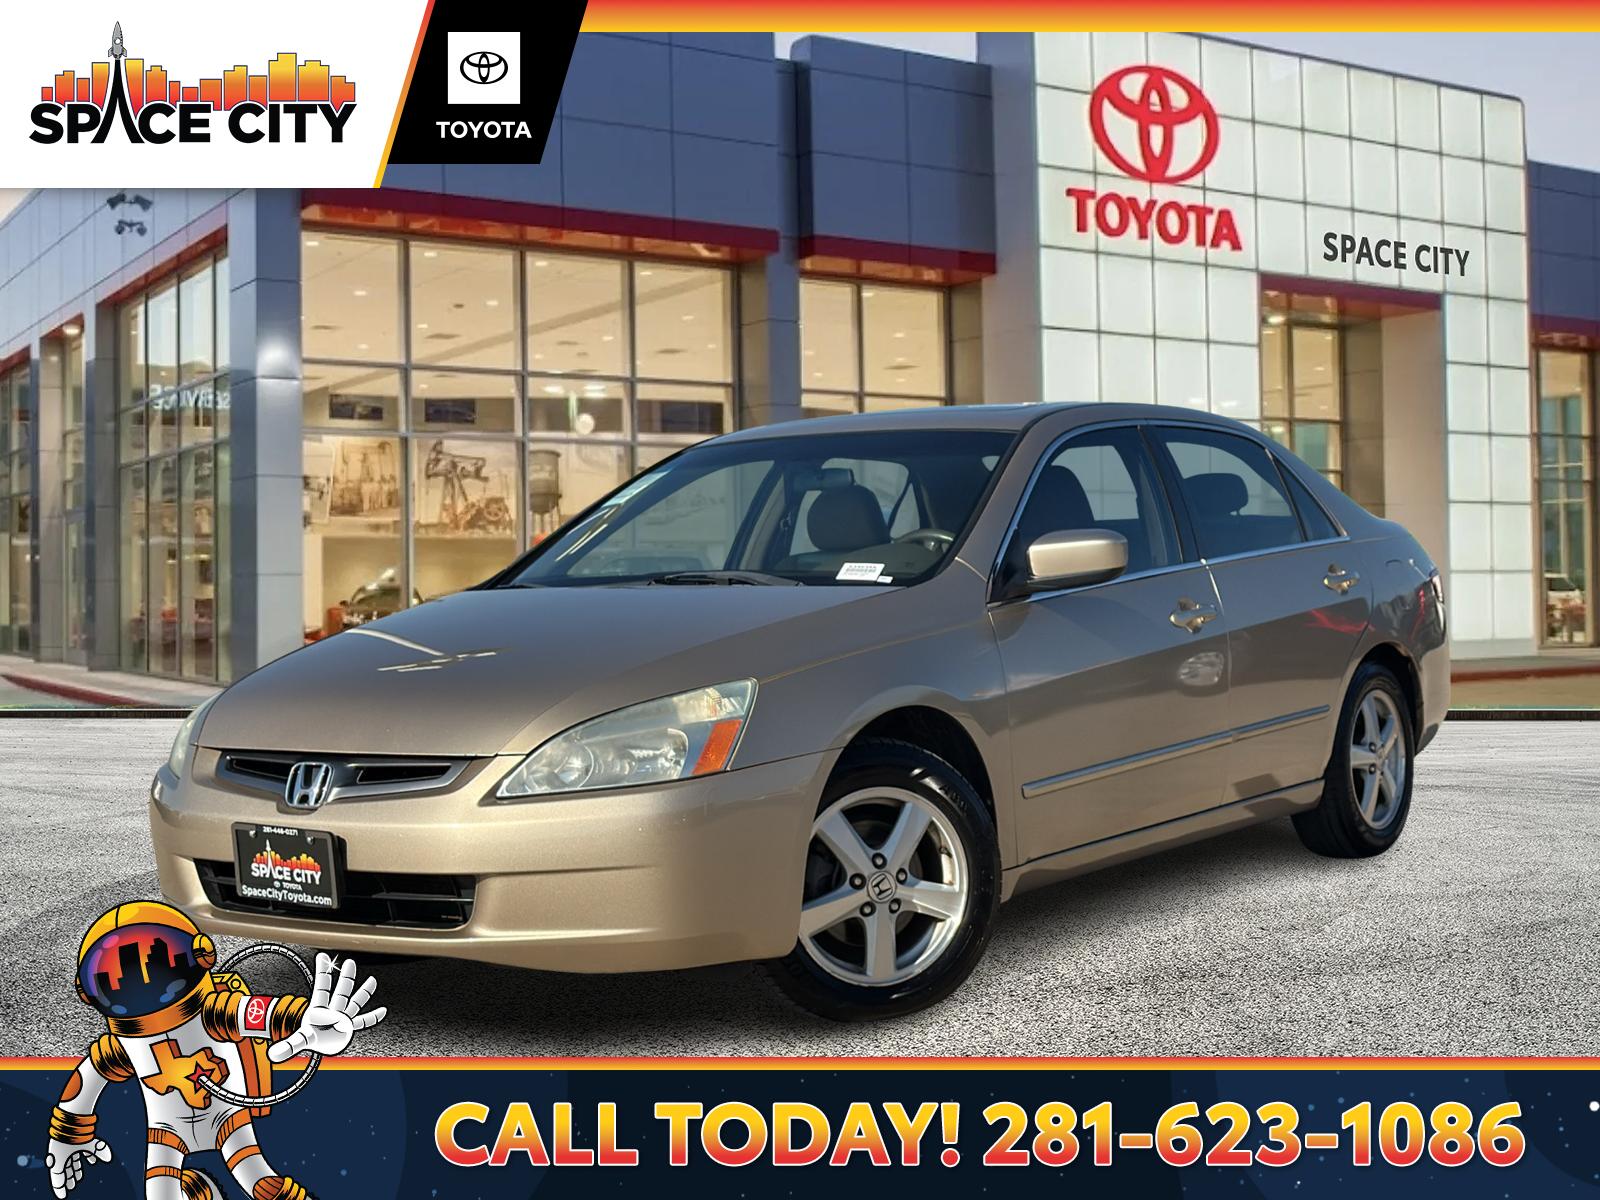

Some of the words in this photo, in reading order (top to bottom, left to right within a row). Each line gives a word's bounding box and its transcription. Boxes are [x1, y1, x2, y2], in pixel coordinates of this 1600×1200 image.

[1066, 188, 1242, 251] TOYOTA
[1323, 232, 1407, 269] SPACE
[1414, 244, 1470, 276] CITY
[251, 857, 292, 881] SPACE
[293, 867, 321, 885] CITY
[241, 885, 333, 906] SpaceCityToyota.com
[282, 881, 303, 891] TOYOTA
